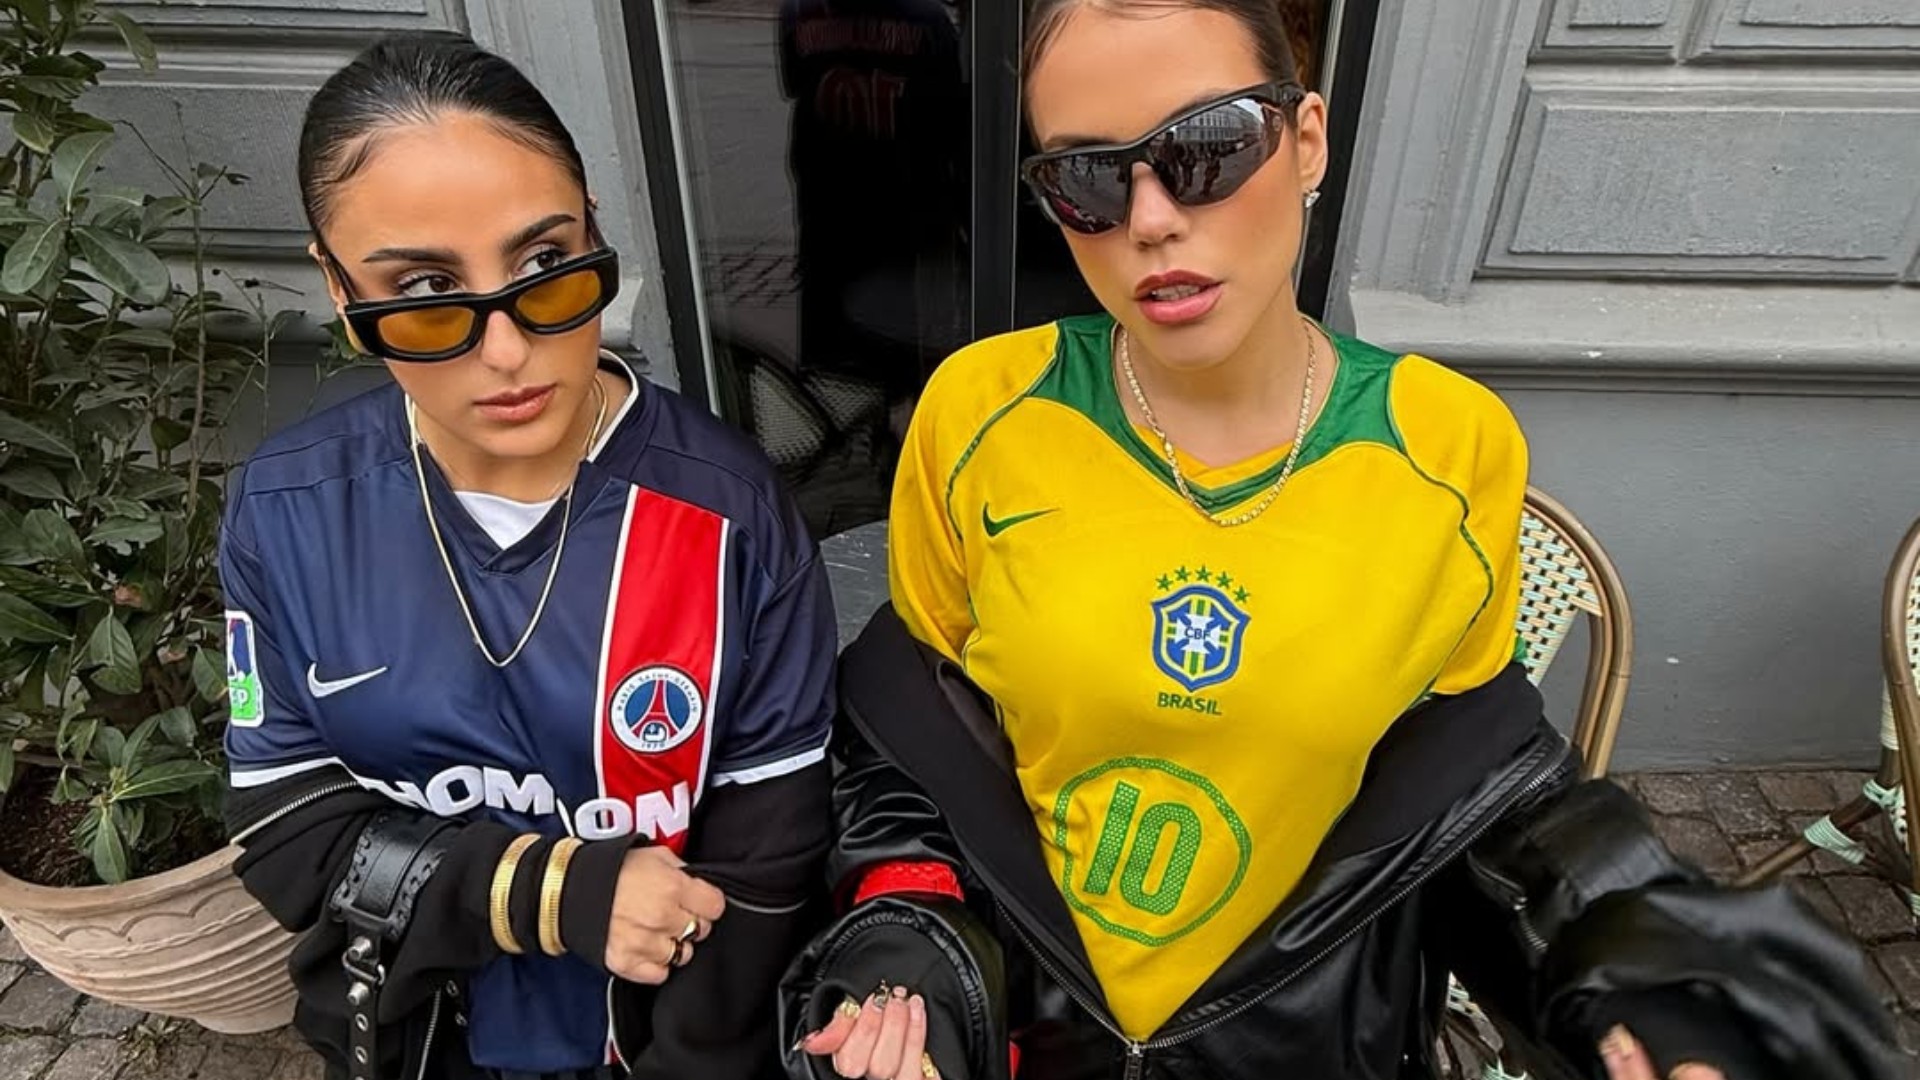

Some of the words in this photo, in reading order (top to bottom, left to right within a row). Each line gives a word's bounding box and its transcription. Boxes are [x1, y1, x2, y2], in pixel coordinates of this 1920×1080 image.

[1184, 627, 1211, 640] CBF
[1157, 692, 1223, 716] BRASIL
[1083, 779, 1203, 916] 10
